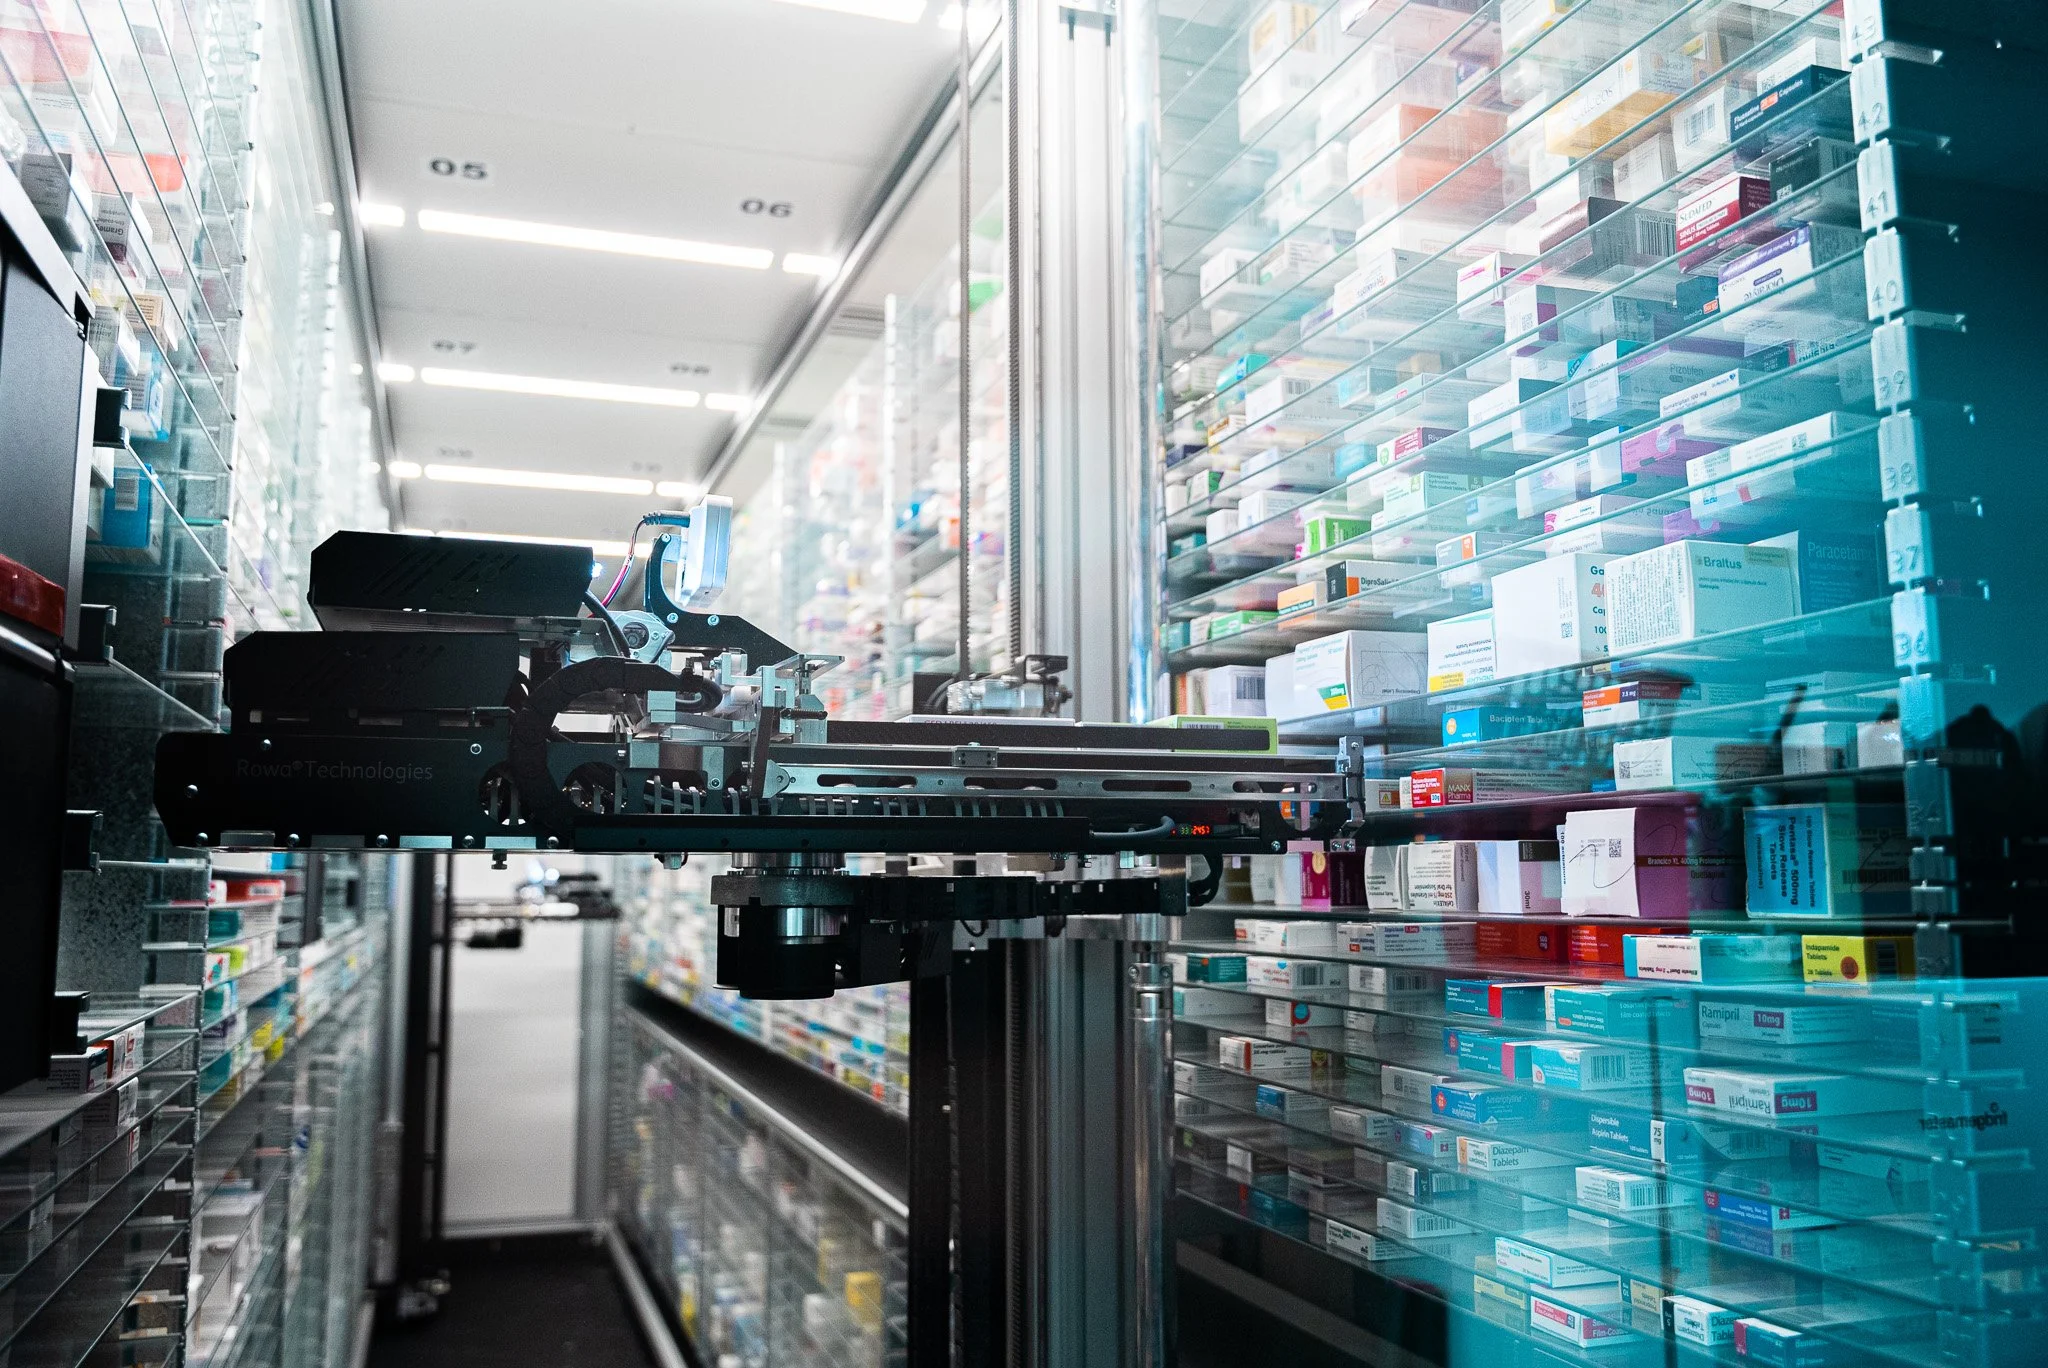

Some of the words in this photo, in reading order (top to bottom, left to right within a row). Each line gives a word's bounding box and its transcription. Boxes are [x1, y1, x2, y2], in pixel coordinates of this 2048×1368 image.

[1851, 16, 1877, 42] 43
[1857, 102, 1884, 130] 42
[428, 156, 489, 181] 05
[740, 197, 795, 220] 06
[1679, 199, 1713, 223] SUDAFED
[1865, 189, 1890, 220] 41
[1871, 279, 1898, 308] 40
[1882, 461, 1914, 491] 38
[1703, 556, 1742, 570] Braltus
[1890, 545, 1920, 575] 37
[1894, 630, 1929, 660] 36
[1489, 714, 1525, 724] Baclofen
[305, 760, 433, 785] Technologies
[1447, 791, 1471, 800] Pharma
[1448, 784, 1471, 792] MANX
[1778, 824, 1787, 853] Slow
[1769, 842, 1777, 880] Tablets
[1779, 854, 1788, 898] Release
[1790, 868, 1799, 906] 500mg
[1805, 943, 1840, 952] Indapamide
[1805, 953, 1827, 961] Tablets
[1814, 968, 1832, 977] Tablets
[1701, 1005, 1740, 1021] Ramipril
[1757, 1012, 1781, 1026] 10mg
[1688, 1087, 1713, 1102] 10mg
[1729, 1095, 1771, 1114] Ramipril
[1780, 1095, 1814, 1109] 10mg
[1590, 1113, 1620, 1128] Dispersible
[1591, 1127, 1610, 1140] Aspirin
[1609, 1130, 1629, 1144] Tablets
[1653, 1127, 1662, 1137] 75
[1653, 1137, 1662, 1147] mg
[1492, 1145, 1529, 1156] Diazepam
[1492, 1157, 1519, 1167] Tablets
